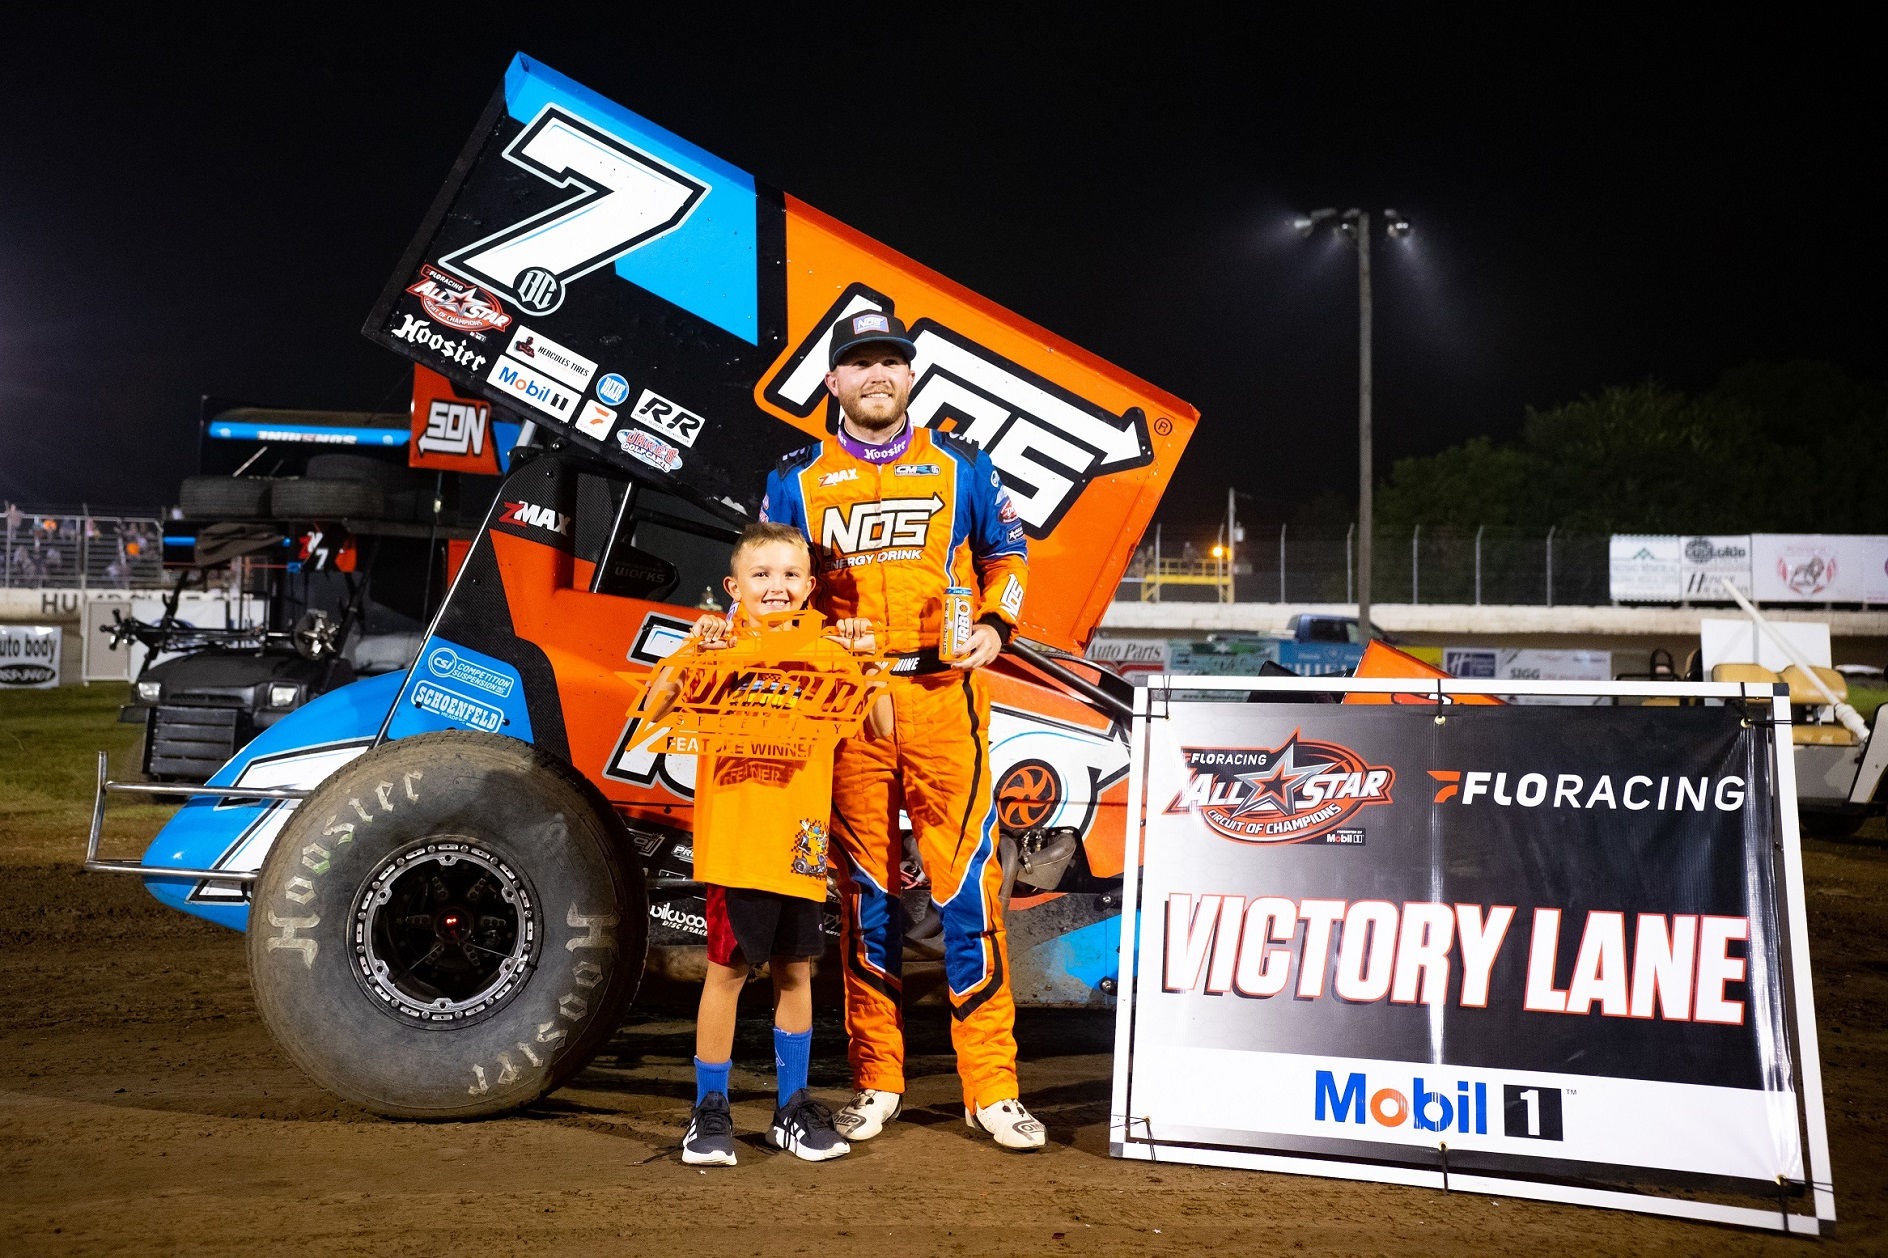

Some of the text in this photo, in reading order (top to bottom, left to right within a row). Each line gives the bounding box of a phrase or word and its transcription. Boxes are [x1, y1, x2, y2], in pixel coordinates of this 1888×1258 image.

[446, 106, 706, 294] 7
[428, 268, 464, 291] FLORACING
[413, 281, 510, 327] ALL STAR
[446, 315, 483, 327] CHAMPIONS
[857, 317, 884, 329] NOS
[391, 314, 487, 371] Hoosier
[537, 345, 590, 377] HERCULES TIRES
[498, 366, 551, 403] Mobil
[639, 397, 701, 439] RR
[864, 440, 907, 460] Hoosier
[822, 493, 945, 556] NOS
[824, 550, 923, 570] ENERGY DRINK
[26, 634, 57, 664] body
[1089, 642, 1161, 661] Auto Parts
[452, 669, 497, 691] SUSPENSION
[457, 663, 511, 688] COMPETITION
[415, 686, 499, 730] SCHOENFELD
[1191, 752, 1267, 766] FLORACING
[1178, 769, 1389, 809] ALL STAR
[1461, 772, 1746, 812] FLORACING
[1206, 803, 1343, 835] CIRCUIT OF CHAMPIONS
[1326, 833, 1353, 843] Mobil
[267, 770, 423, 969] Hoosier
[650, 902, 707, 929] wilwoo
[662, 920, 682, 930] DISC
[1162, 892, 1749, 1025] VICTORY LANE
[1314, 1070, 1487, 1135] Mobil
